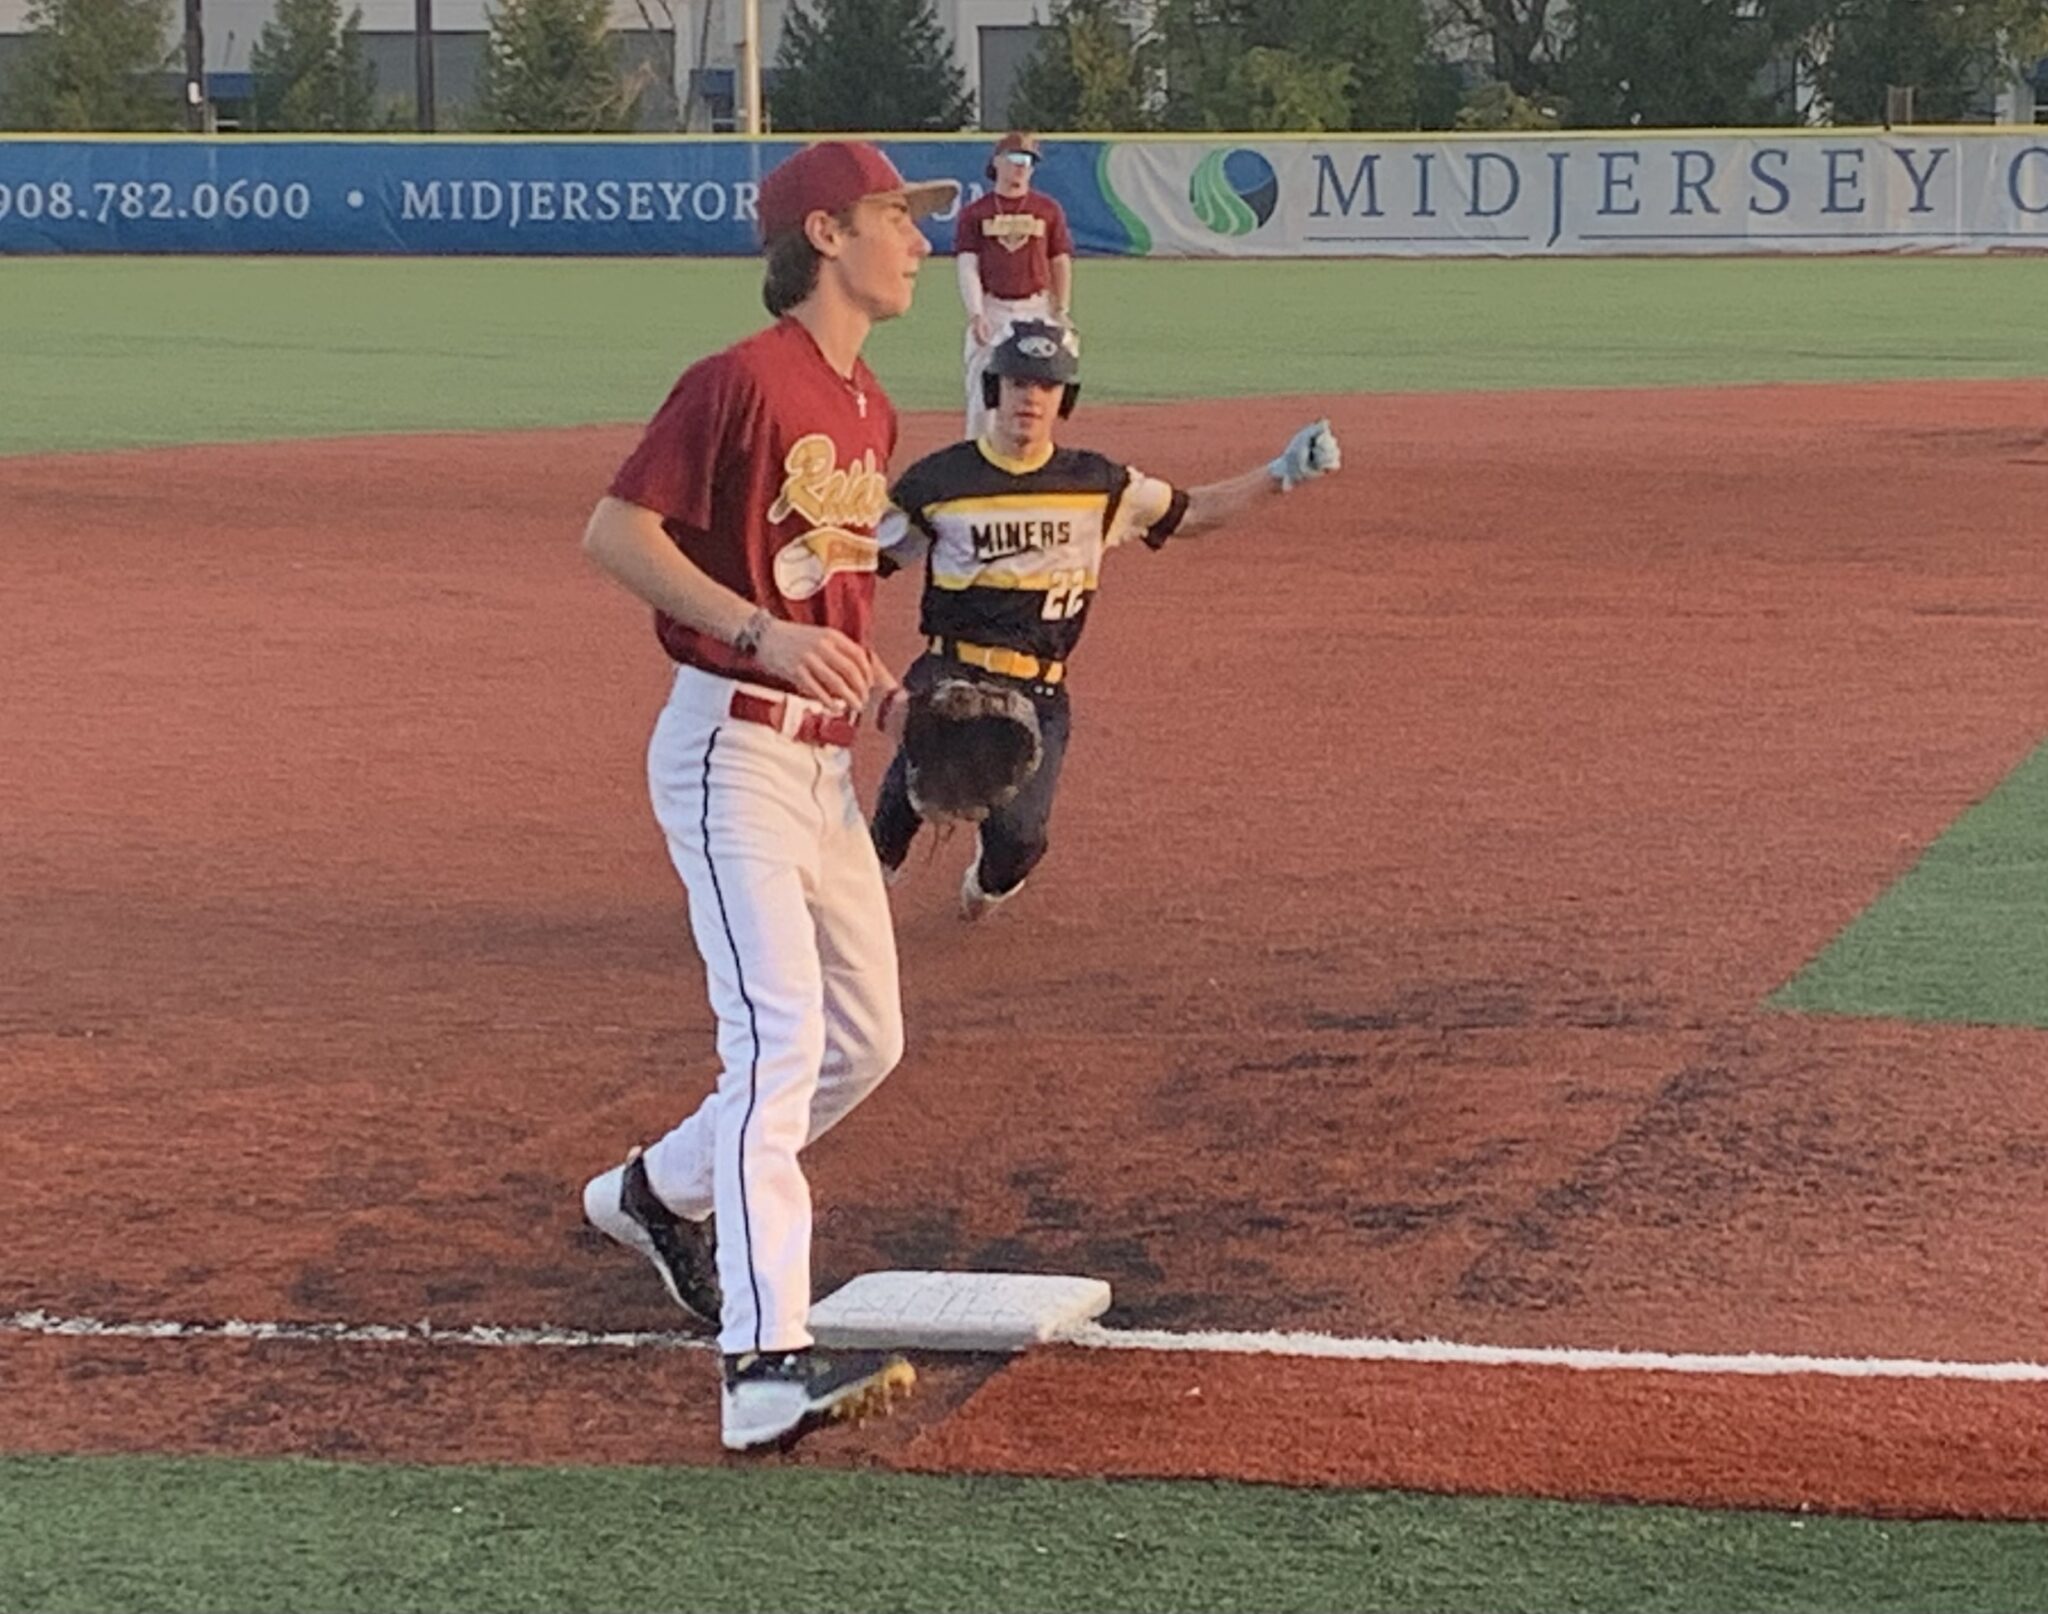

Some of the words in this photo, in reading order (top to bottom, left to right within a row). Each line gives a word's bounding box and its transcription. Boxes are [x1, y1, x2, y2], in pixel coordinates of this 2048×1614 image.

[401, 180, 760, 228] MIDJERSEYOR
[1309, 147, 1950, 247] MIDJERSEY
[969, 520, 1071, 558] MINERS
[1041, 568, 1085, 621] 22
